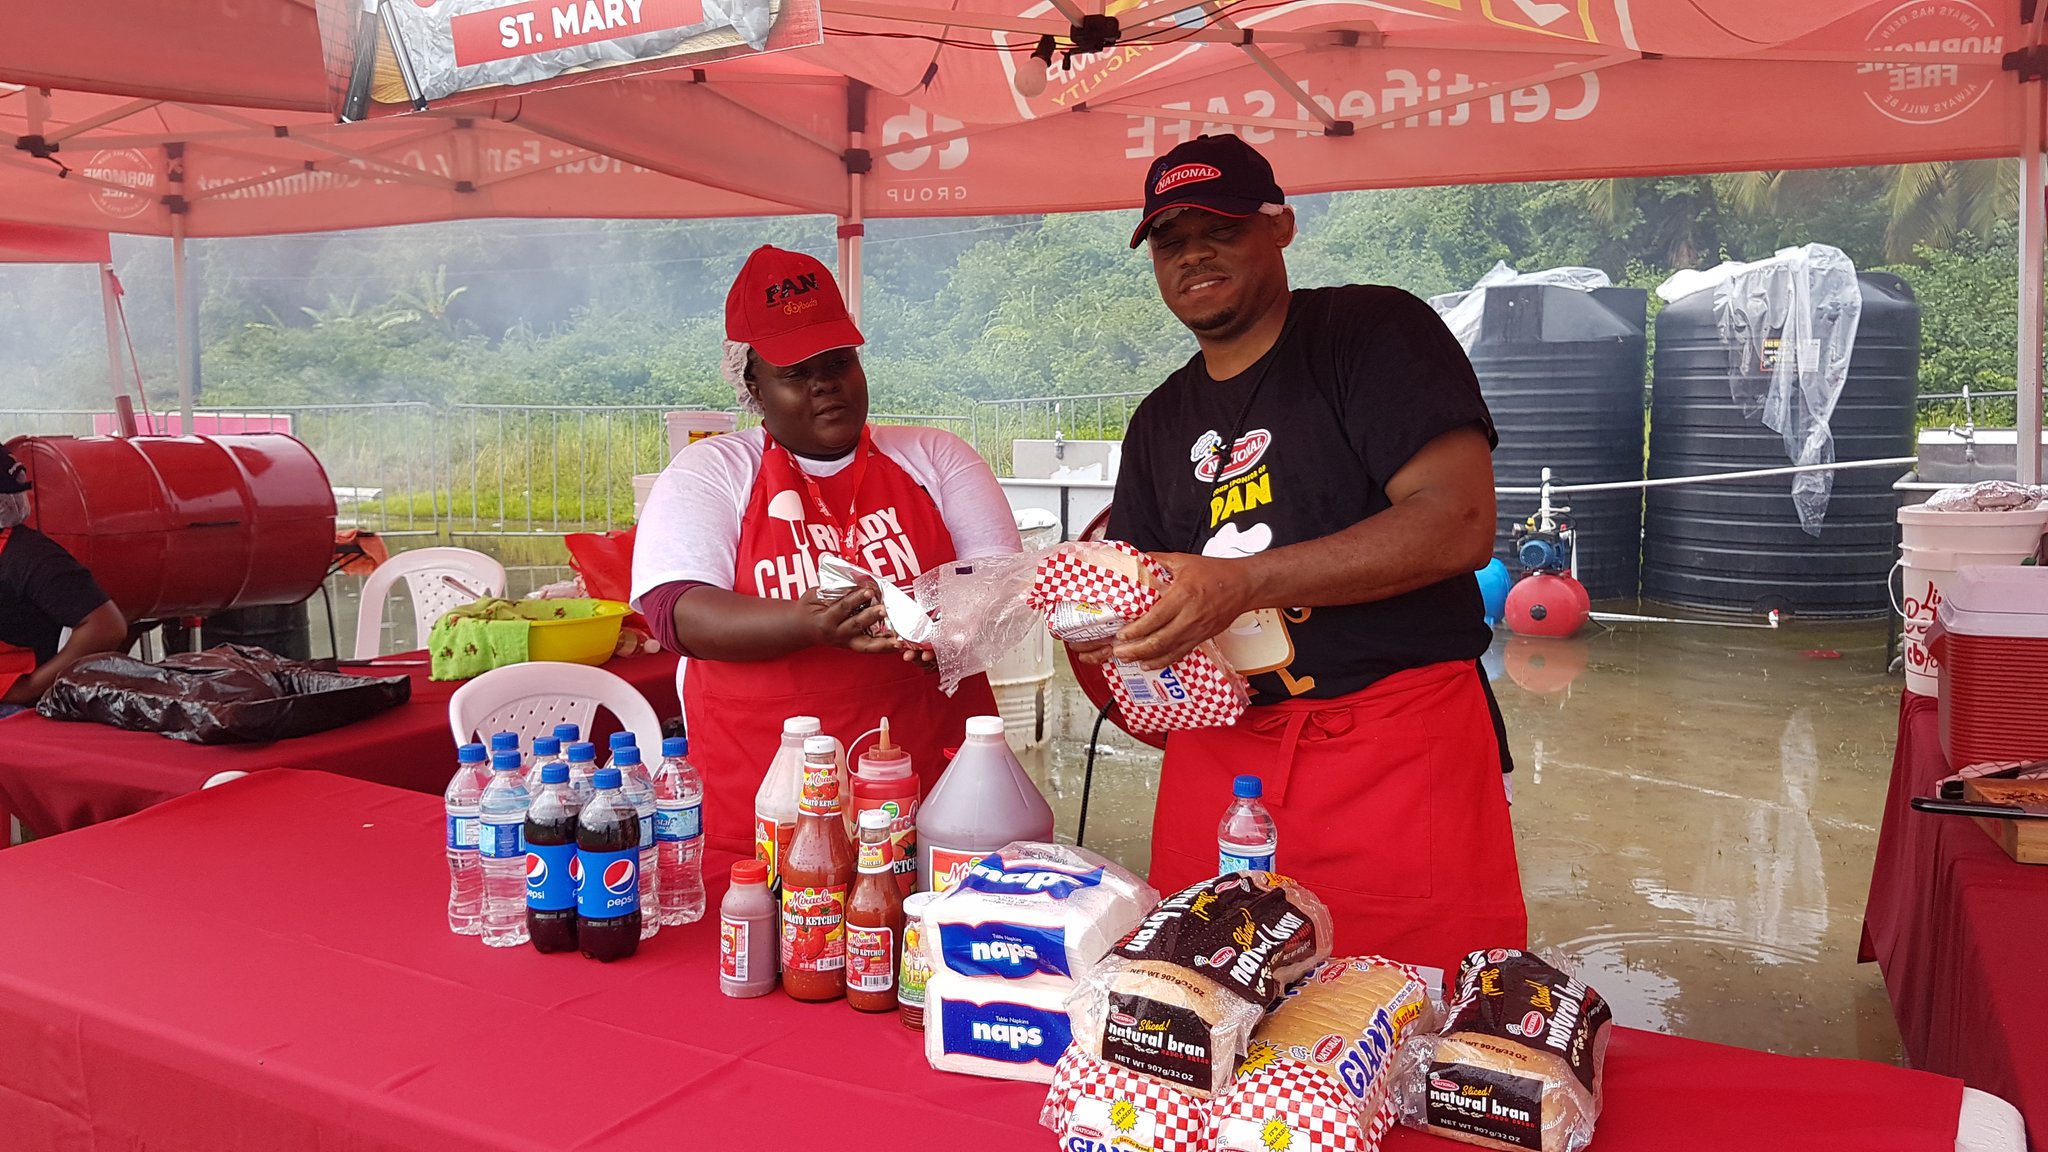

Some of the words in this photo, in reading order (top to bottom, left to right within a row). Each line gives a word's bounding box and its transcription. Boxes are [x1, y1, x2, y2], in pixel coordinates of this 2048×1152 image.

[499, 12, 543, 49] ST.
[551, 0, 644, 38] MARY
[1158, 168, 1215, 192] NATIONAL
[1207, 437, 1264, 474] NTIONAL
[1229, 470, 1258, 488] SPONSOR
[1210, 472, 1273, 529] PAN
[753, 533, 922, 600] CHIEN
[1160, 666, 1186, 699] GIA
[893, 858, 917, 874] ETCH
[607, 893, 634, 908] pepsi
[789, 889, 832, 907] Miracle
[806, 914, 842, 926] KETCHUP
[1124, 911, 1182, 951] bran
[971, 941, 1038, 965] naps
[1193, 987, 1205, 997] OZ
[1480, 968, 1504, 996] Sliced!
[1009, 1017, 1029, 1025] Napkins
[1139, 1019, 1171, 1031] Sliced!
[972, 1022, 1043, 1049] naps
[1108, 1022, 1164, 1048] natural
[1167, 1034, 1205, 1058] bran
[1319, 1035, 1342, 1063] NATIONAL
[1339, 1007, 1395, 1099] GIANT
[1515, 1053, 1528, 1061] OZ
[1115, 1053, 1131, 1063] NET
[1132, 1060, 1146, 1068] WT
[1147, 1064, 1180, 1078] 907g/32
[1181, 1073, 1194, 1081] OZ
[1462, 1085, 1493, 1096] Sliced!
[1430, 1089, 1487, 1112] natural
[1492, 1099, 1529, 1122] bran
[1073, 1126, 1103, 1137] NATIONAL
[1269, 1126, 1278, 1137] IT'S
[1441, 1118, 1456, 1126] NET
[1459, 1122, 1472, 1130] WT
